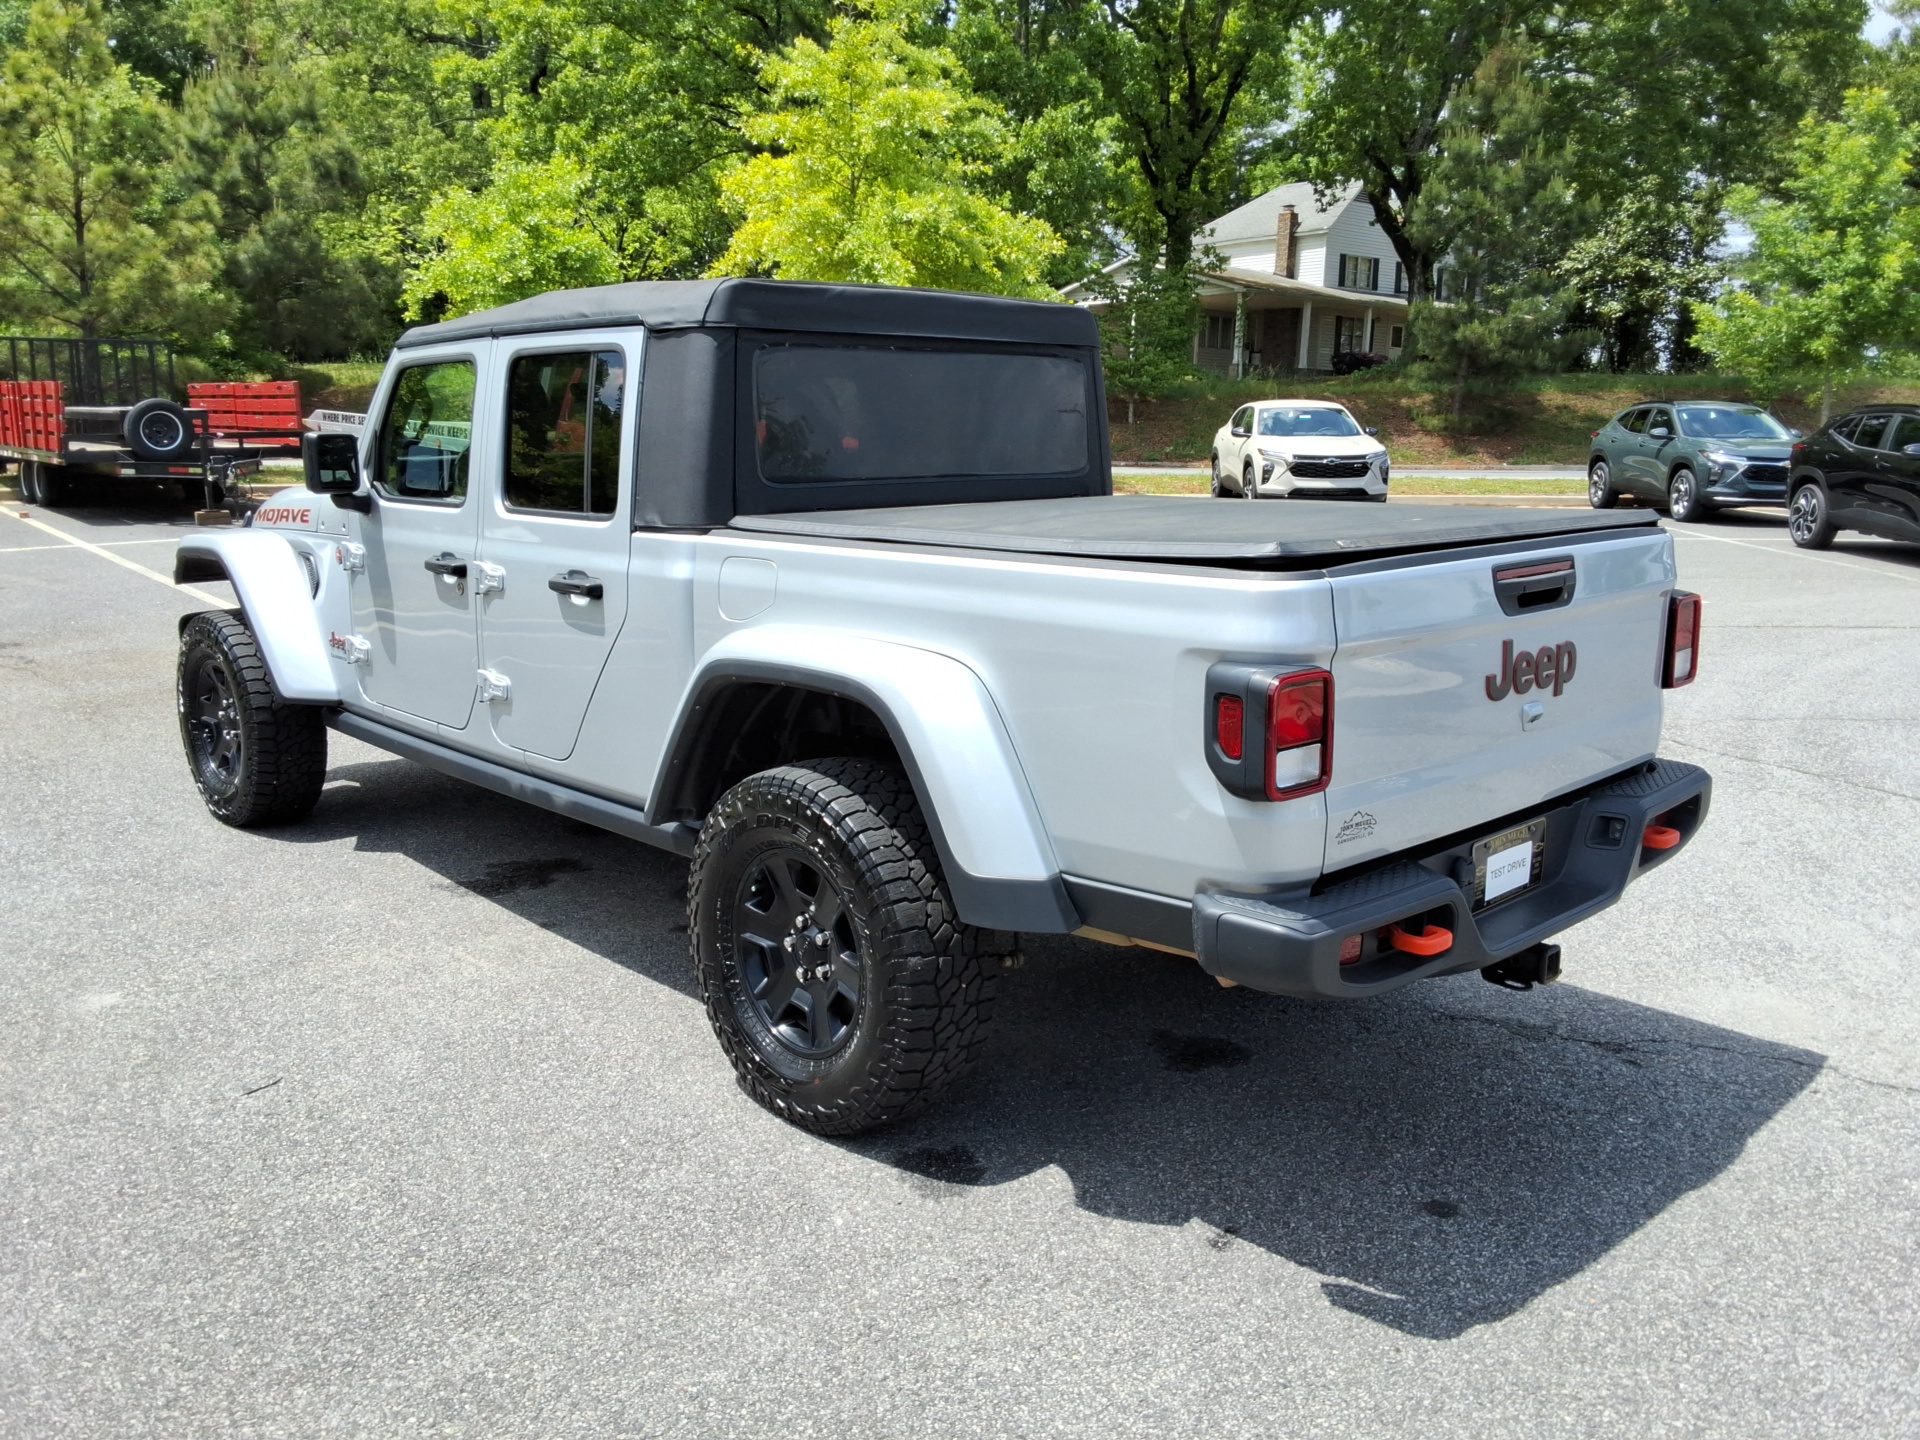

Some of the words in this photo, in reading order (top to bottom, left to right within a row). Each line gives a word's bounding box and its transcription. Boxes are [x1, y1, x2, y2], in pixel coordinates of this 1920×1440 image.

[322, 412, 340, 423] WHERE
[341, 414, 356, 425] PRICE
[447, 426, 468, 440] KEEPS
[255, 508, 311, 525] MOJAVE
[1485, 638, 1577, 702] Jeep
[1490, 865, 1506, 880] TEST
[1507, 857, 1527, 873] DRIVE
